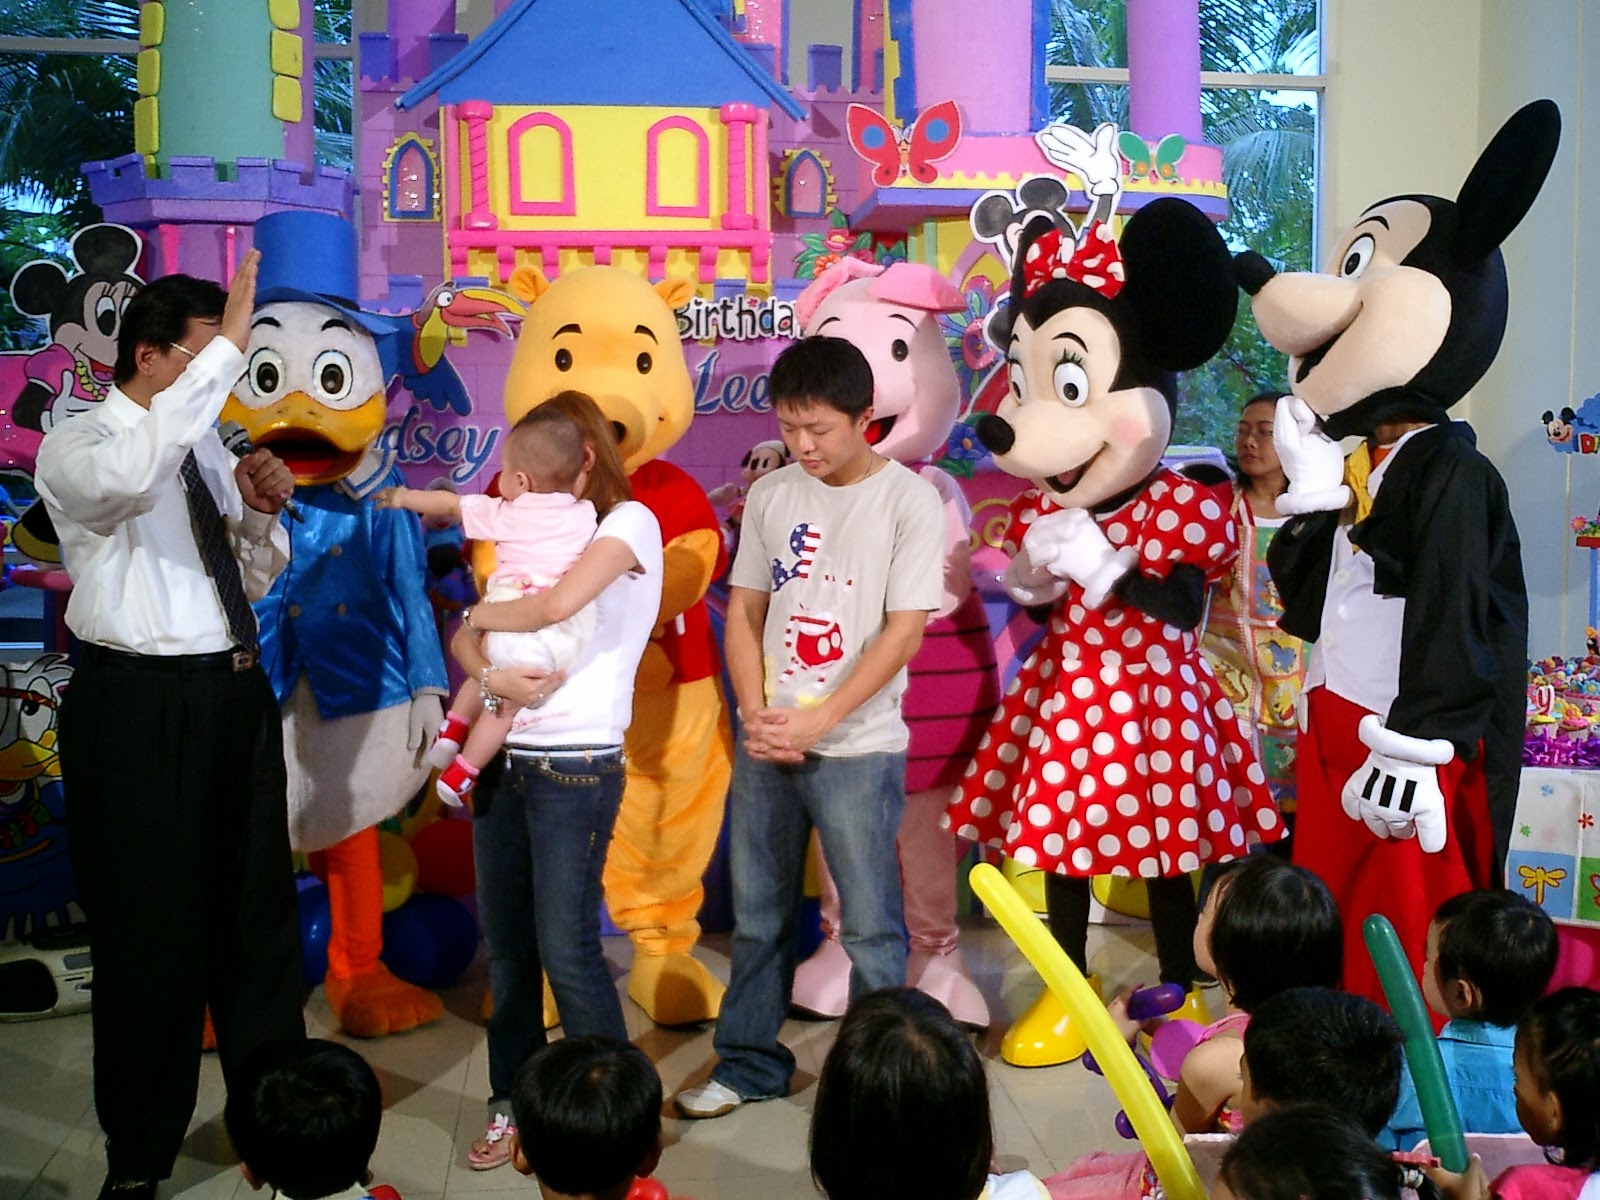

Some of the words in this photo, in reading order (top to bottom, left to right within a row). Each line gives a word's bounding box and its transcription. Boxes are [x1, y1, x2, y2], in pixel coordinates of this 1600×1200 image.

[673, 295, 805, 340] Birthda
[694, 349, 771, 414] Lee
[376, 405, 502, 485] dsey
